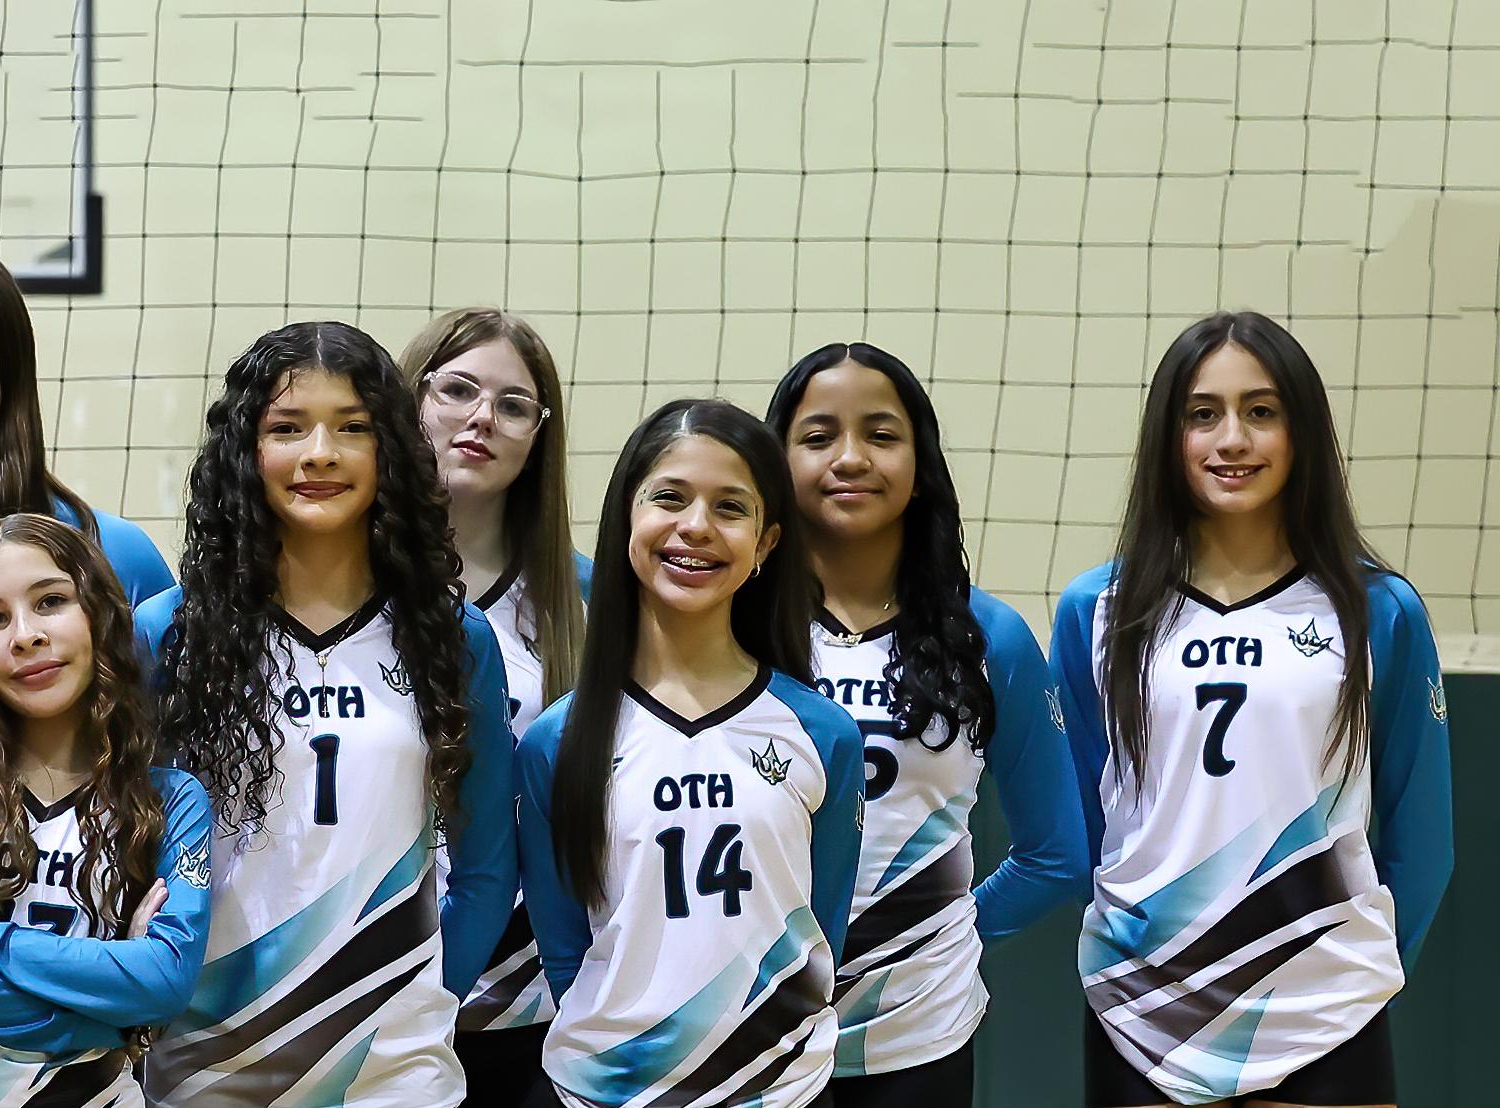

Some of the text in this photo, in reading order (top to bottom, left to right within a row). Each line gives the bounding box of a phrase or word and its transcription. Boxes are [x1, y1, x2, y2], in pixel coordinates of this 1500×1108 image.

[1182, 636, 1263, 668] OTH
[283, 685, 365, 718] OTH
[1195, 682, 1248, 777] 7
[309, 733, 341, 826] 1
[653, 773, 734, 812] OTH
[654, 823, 753, 920] 14
